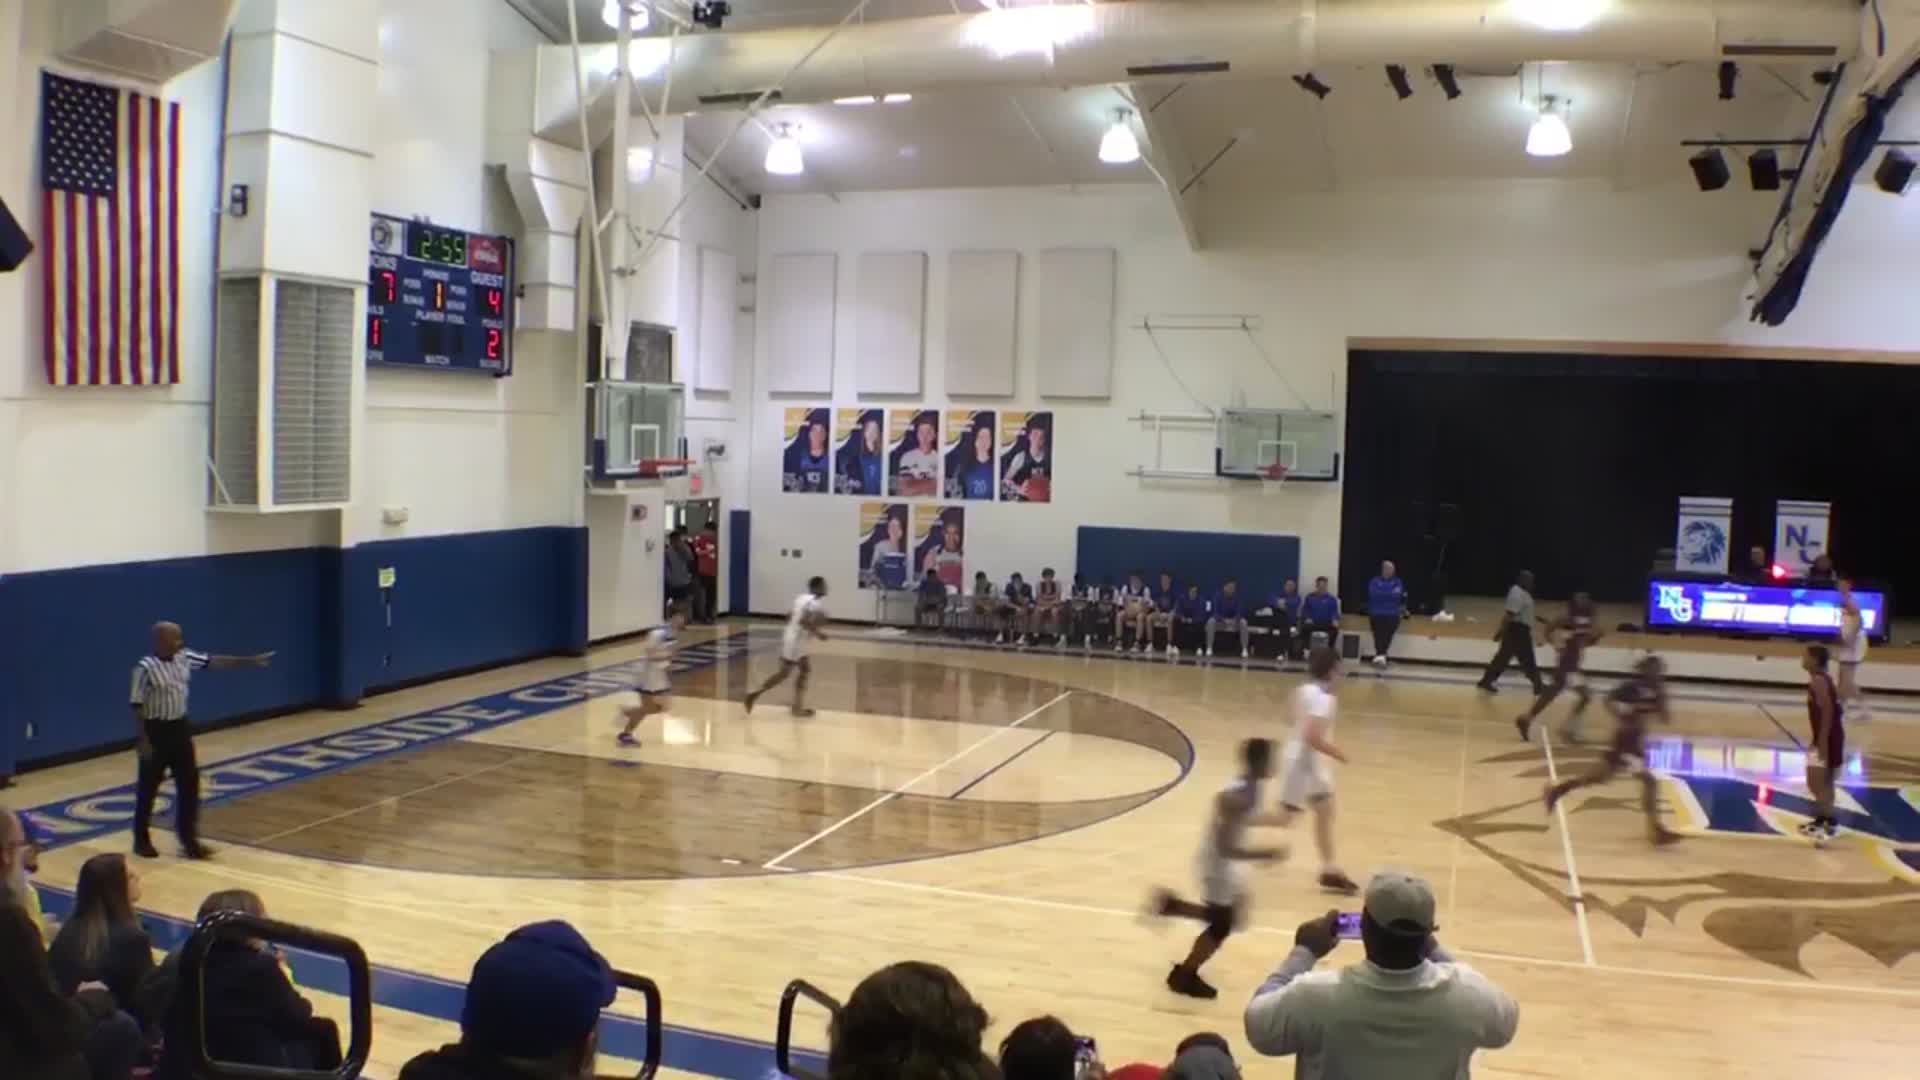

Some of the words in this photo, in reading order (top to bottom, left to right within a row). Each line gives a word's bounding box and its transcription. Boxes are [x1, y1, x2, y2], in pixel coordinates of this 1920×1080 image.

[420, 229, 465, 264] 2:55
[381, 271, 396, 302] 7
[470, 271, 504, 287] GUEST
[435, 281, 442, 310] 1
[487, 291, 502, 315] 4
[372, 319, 379, 346] 1
[487, 329, 500, 358] 2
